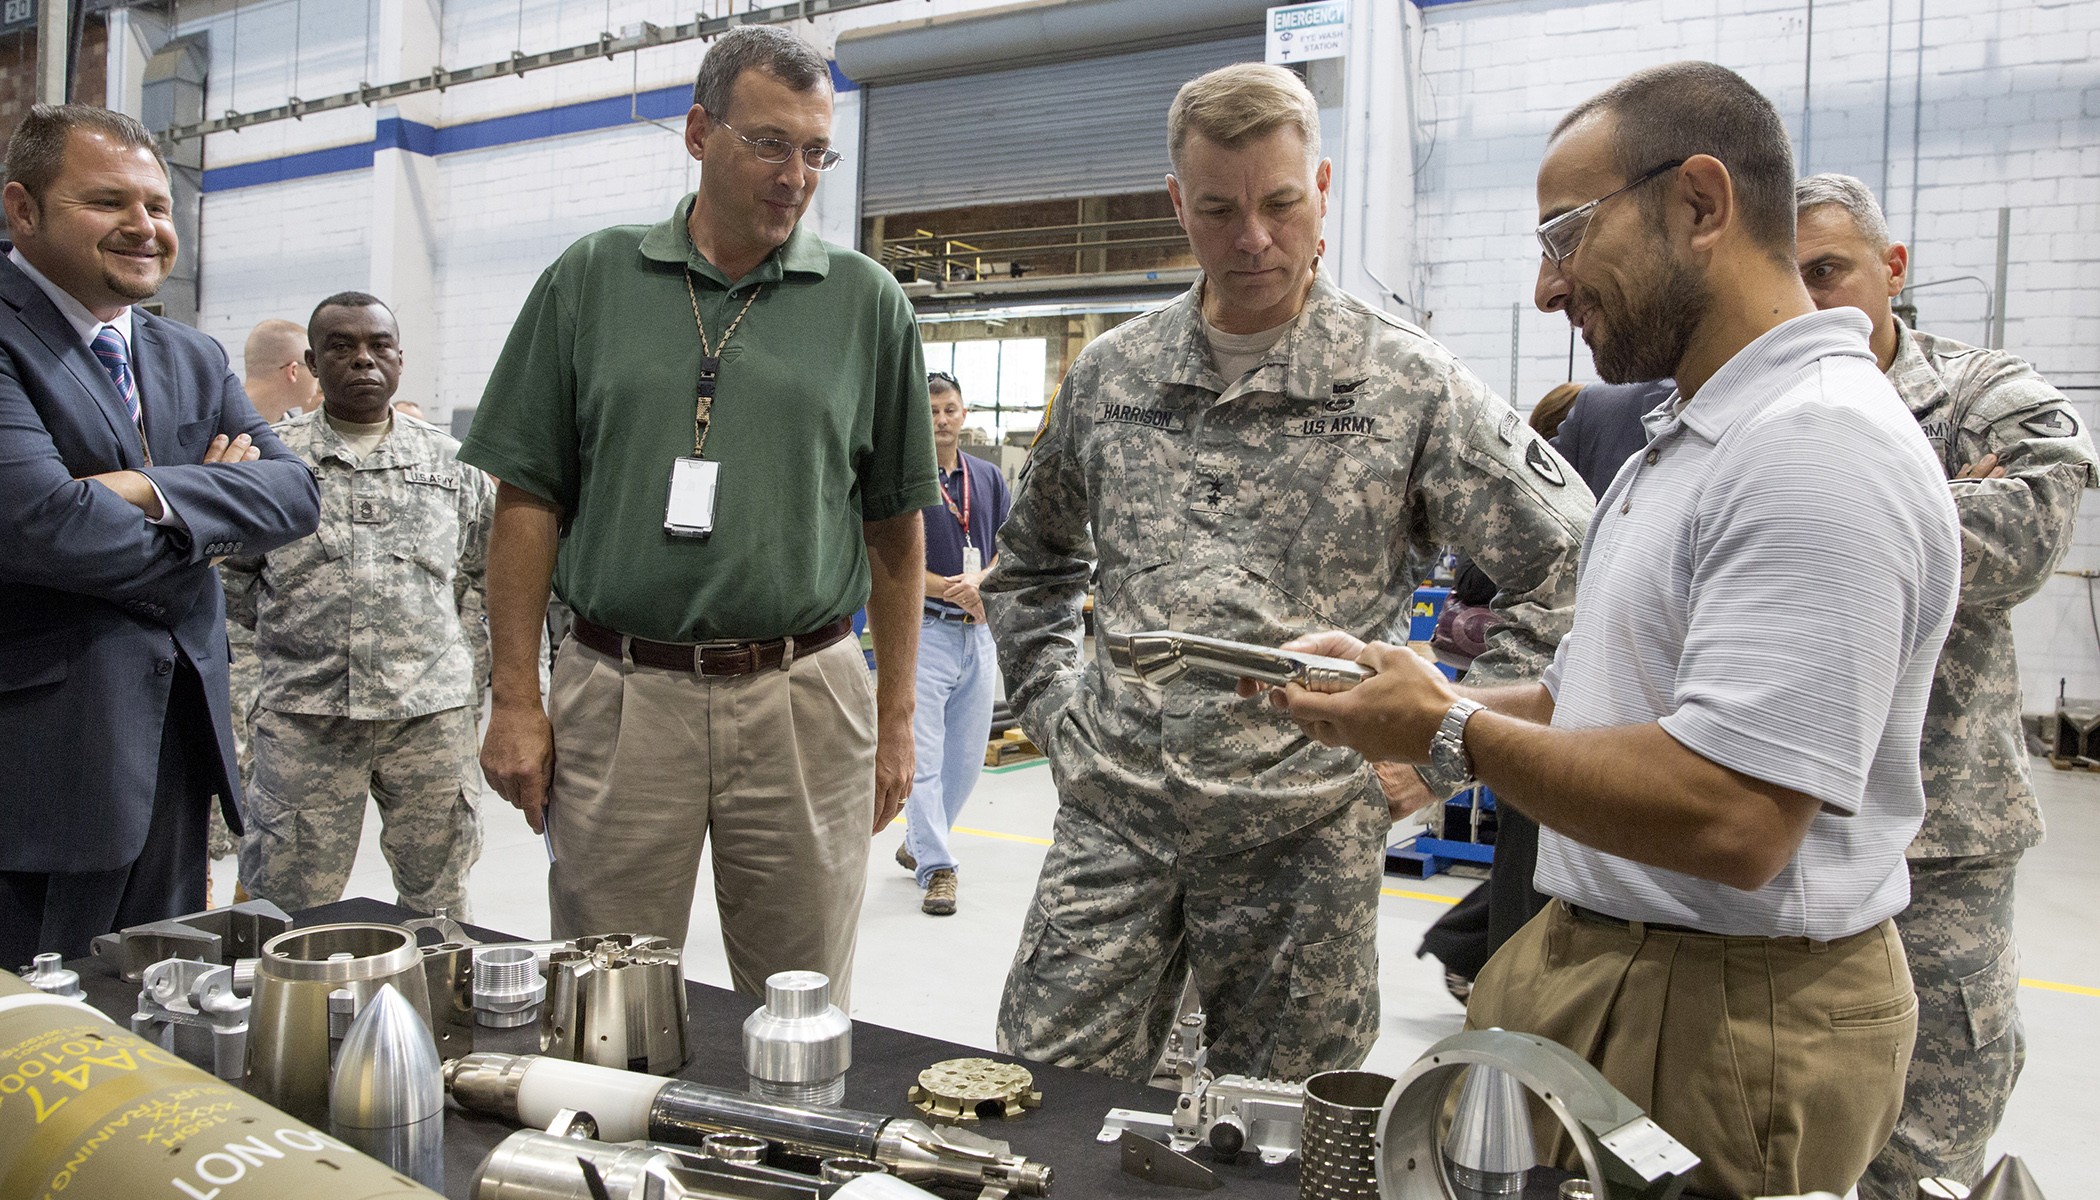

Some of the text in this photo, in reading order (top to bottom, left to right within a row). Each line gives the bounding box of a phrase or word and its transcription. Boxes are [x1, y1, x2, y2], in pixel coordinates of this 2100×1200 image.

[1275, 6, 1343, 30] EMERGENCY
[1300, 31, 1343, 42] EYE WASH
[1304, 42, 1338, 52] STATION
[1104, 405, 1172, 427] HARRISON
[1330, 415, 1376, 434] ARMY
[1921, 422, 1950, 438] RMY
[171, 1135, 286, 1200] NOT
